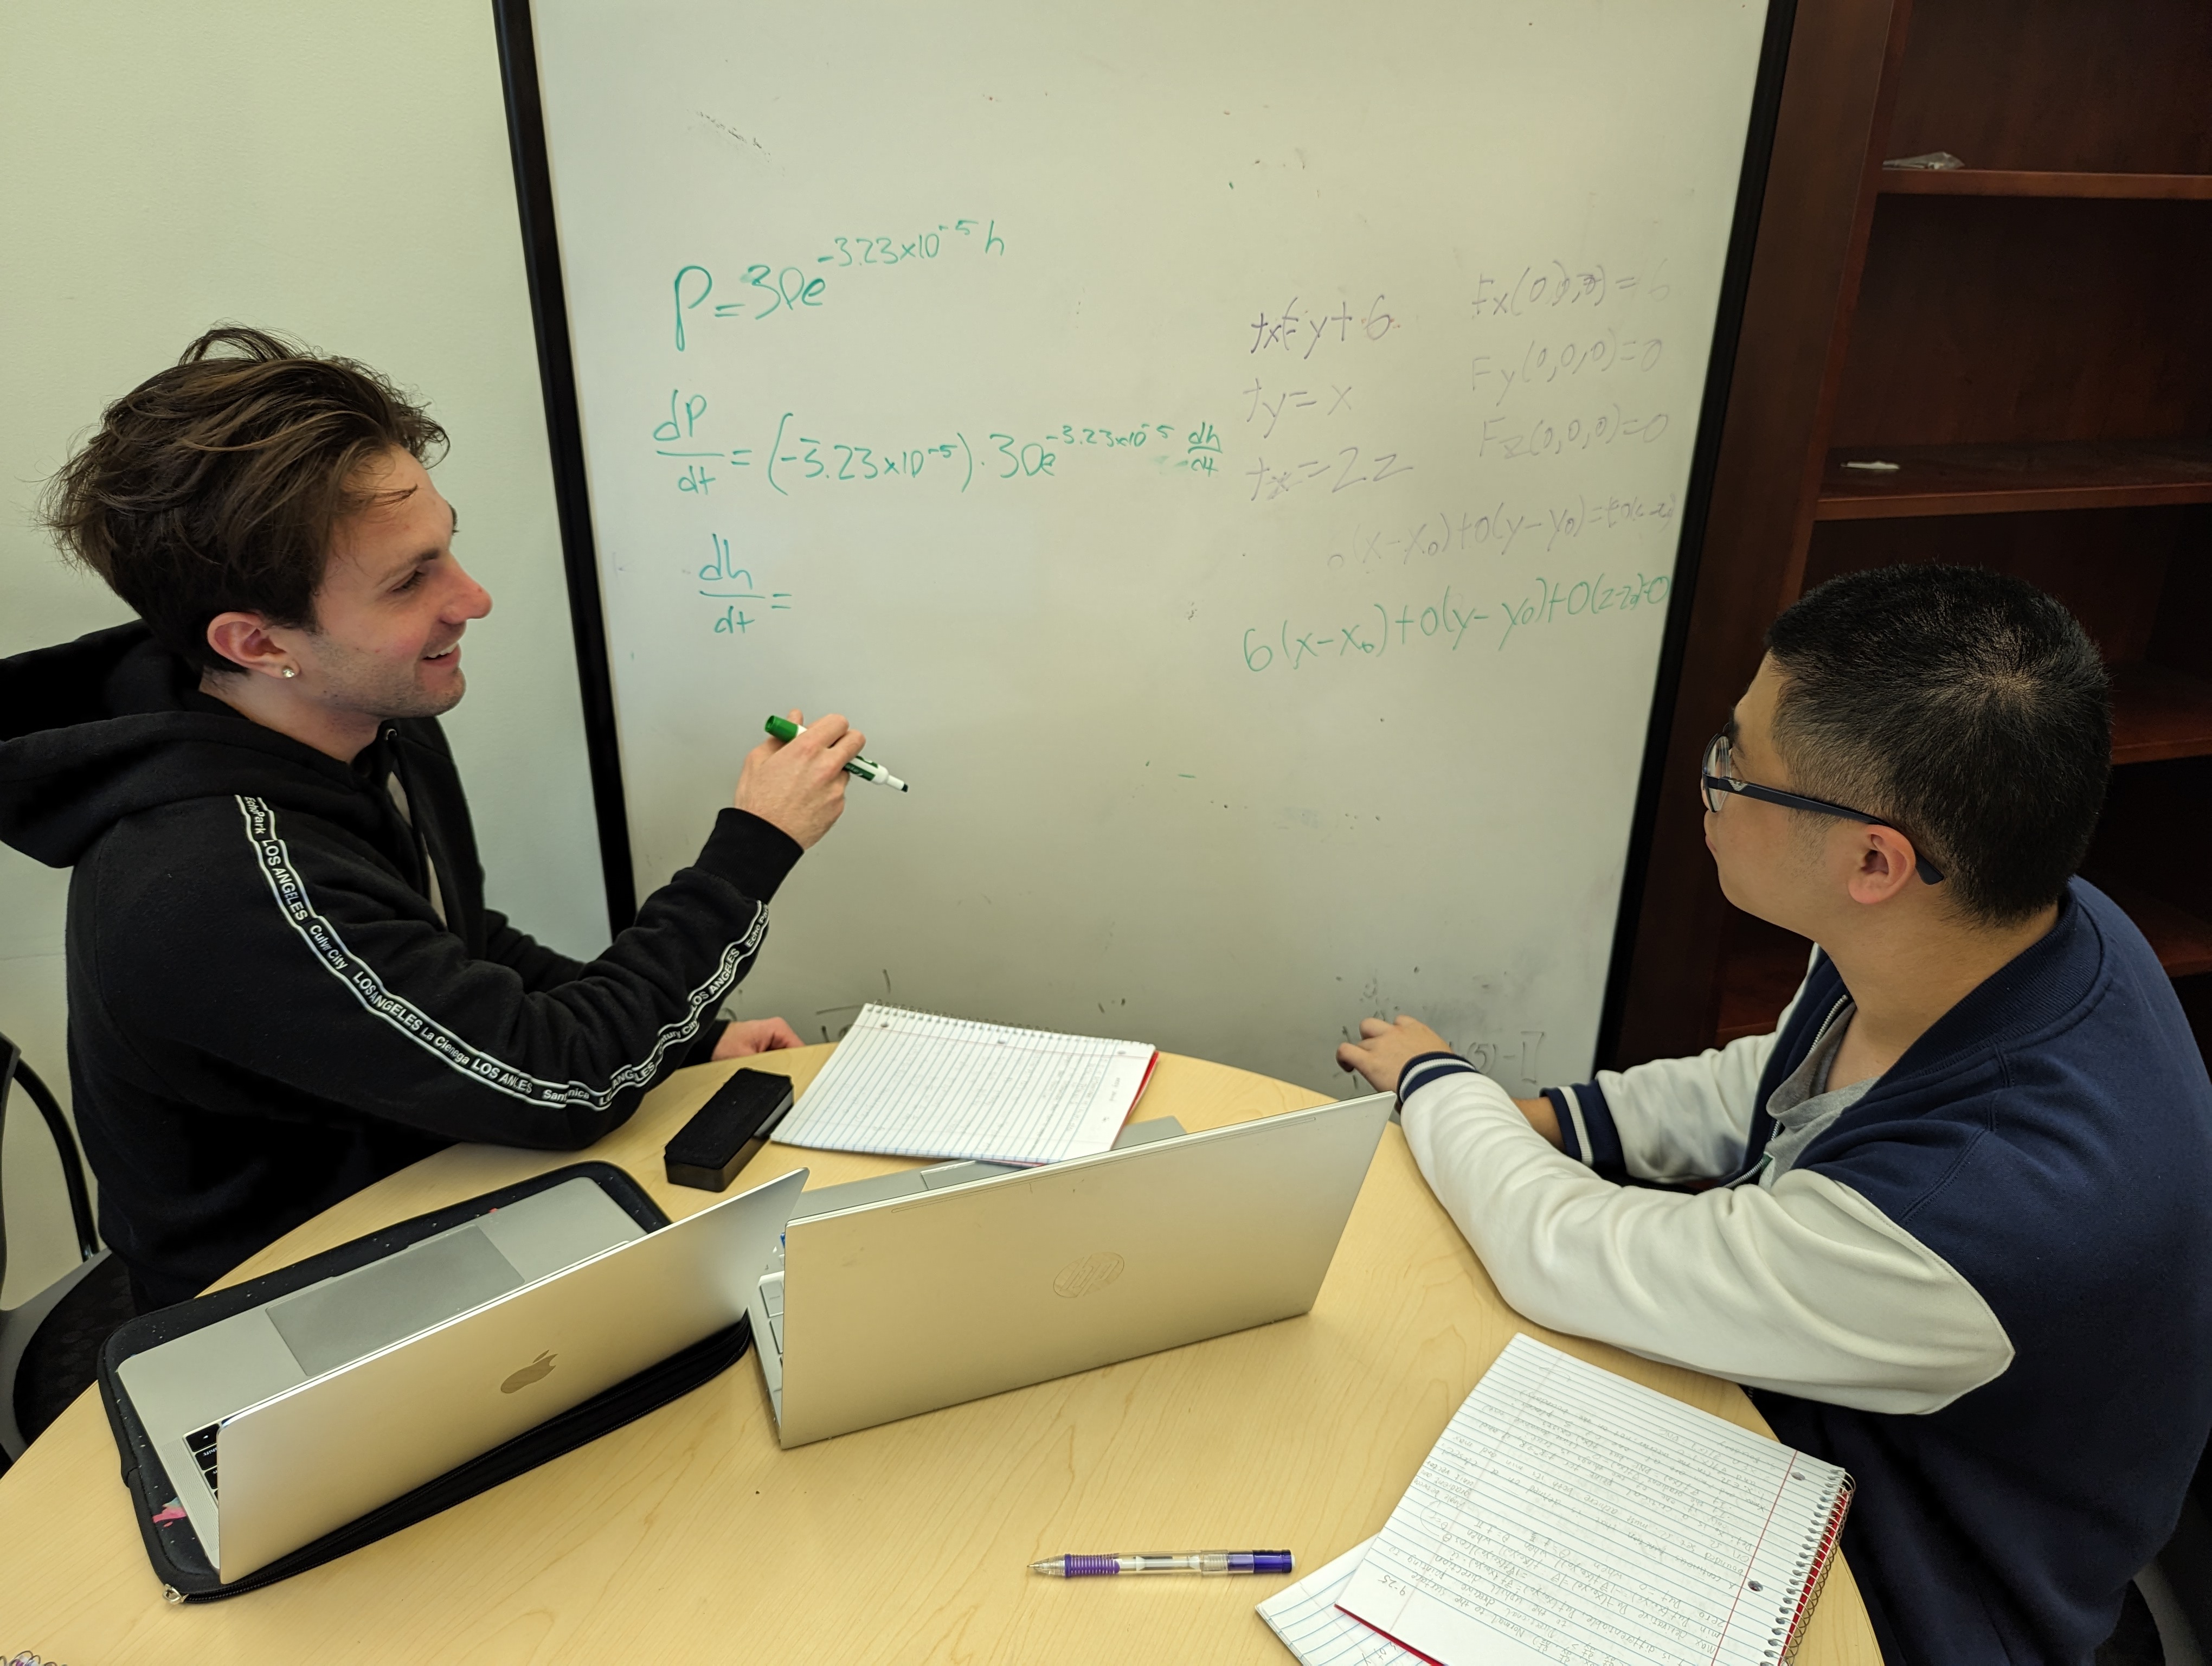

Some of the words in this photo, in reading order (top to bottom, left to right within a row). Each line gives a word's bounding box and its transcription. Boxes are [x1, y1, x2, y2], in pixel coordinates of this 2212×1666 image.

[253, 811, 266, 835] Park
[262, 839, 281, 867] LOS
[272, 868, 308, 921] ANGELES
[326, 949, 349, 971] City
[352, 971, 375, 995] LOS
[370, 991, 423, 1031] ANGELES
[421, 1026, 435, 1041] La
[435, 1036, 470, 1065] Cienega
[472, 1058, 500, 1079] LOS
[709, 948, 740, 996] ANGELES
[745, 924, 761, 948] Echo
[1478, 1421, 1497, 1434] and
[1452, 1434, 1472, 1447] max
[1480, 1446, 1497, 1459] and
[1424, 1459, 1450, 1476] vector
[1505, 1459, 1523, 1470] min
[1562, 1458, 1580, 1471] for
[1576, 1453, 1605, 1472] things
[1453, 1473, 1474, 1487] unit
[1507, 1476, 1520, 1486] on
[1532, 1471, 1544, 1480] its
[1589, 1469, 1613, 1486] point
[1611, 1471, 1625, 1481] two
[1411, 1477, 1440, 1497] between
[1433, 1474, 1471, 1498] gradient
[1551, 1480, 1573, 1496] both
[1443, 1492, 1465, 1509] Angle
[1525, 1483, 1561, 1509] defined
[1626, 1489, 1671, 1514] critical
[1661, 1494, 1675, 1504] one
[1690, 1496, 1703, 1506] the
[1570, 1507, 1581, 1517] is
[1593, 1516, 1617, 1532] that
[1626, 1515, 1648, 1530] must
[1465, 1529, 1490, 1547] when
[1679, 1539, 1696, 1552] set
[1388, 1546, 1400, 1555] to
[1522, 1542, 1547, 1561] when
[1732, 1550, 1749, 1563] on
[1405, 1553, 1446, 1579] pointing
[1432, 1555, 1481, 1585] direction
[1703, 1550, 1744, 1576] bounded
[1591, 1562, 1622, 1582] when
[1408, 1570, 1448, 1596] surface
[1453, 1595, 1470, 1608] the
[1489, 1581, 1523, 1606] uphill
[1474, 1606, 1484, 1614] to
[1531, 1604, 1547, 1617] the
[1489, 1613, 1526, 1637] Normal
[1555, 1618, 1567, 1628] to
[1636, 1610, 1688, 1641] derivative
[1697, 1610, 1725, 1628] zero
[1698, 1625, 1720, 1642] min
